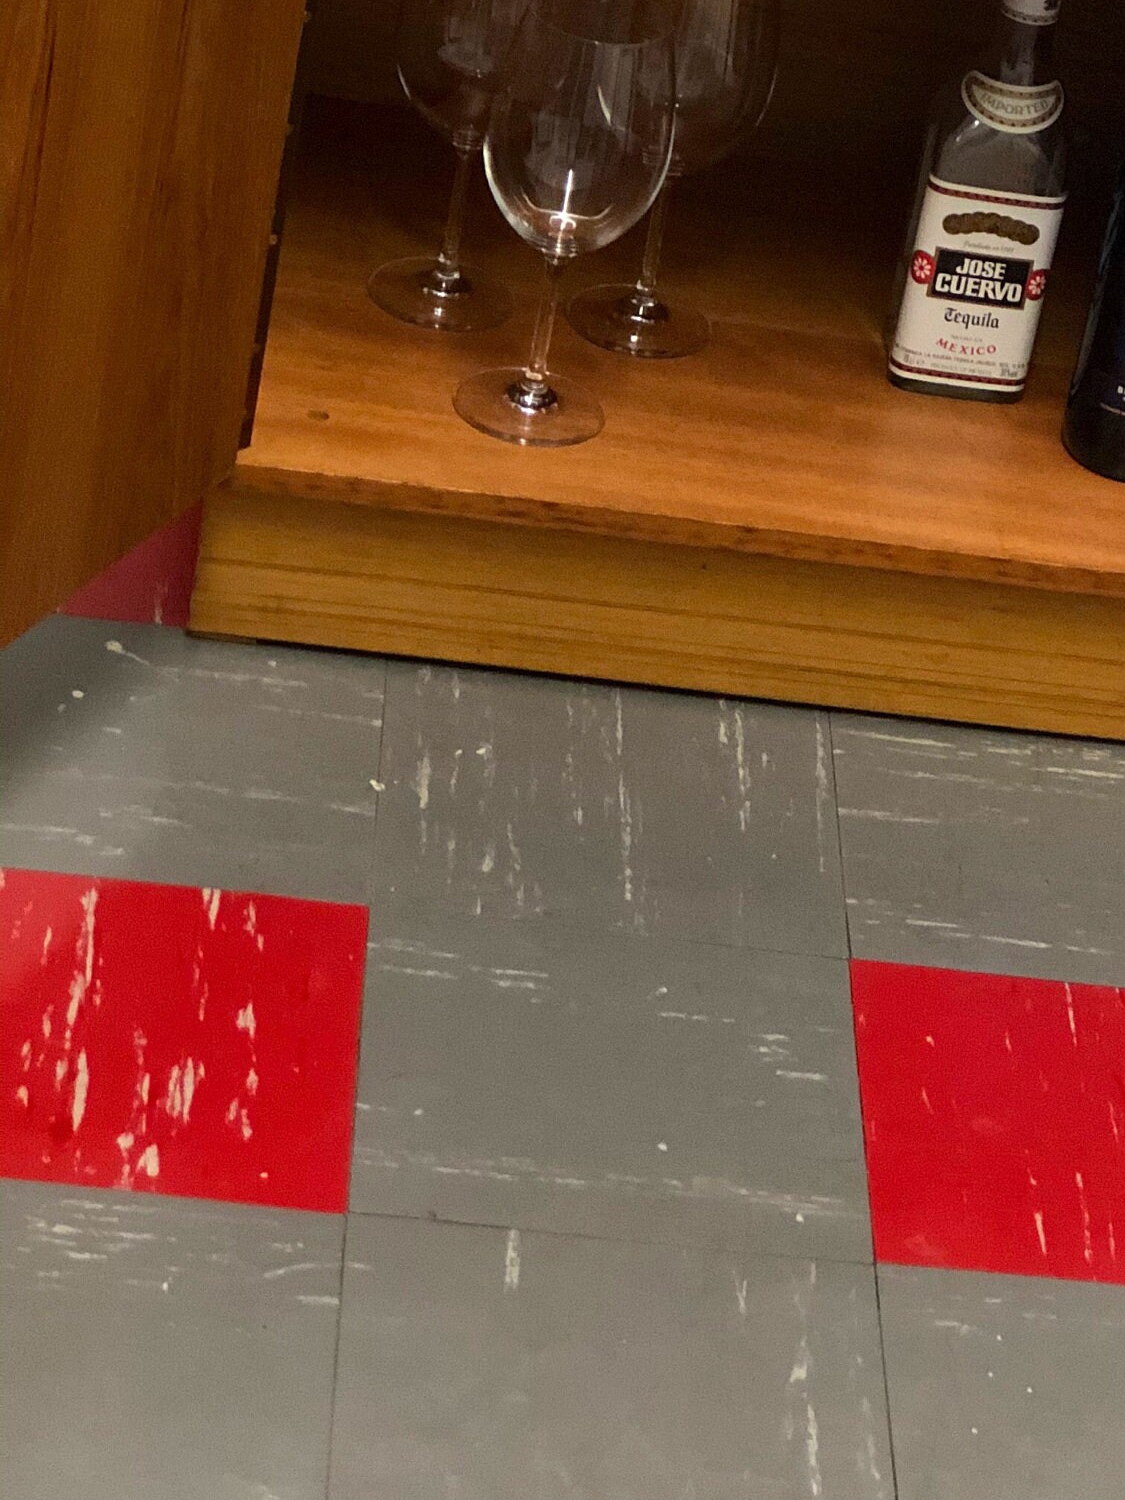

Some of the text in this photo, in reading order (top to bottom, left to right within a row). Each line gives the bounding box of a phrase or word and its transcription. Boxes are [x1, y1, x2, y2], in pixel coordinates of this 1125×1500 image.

[982, 91, 1049, 115] IMPORTED
[955, 258, 1007, 280] JOSE
[935, 272, 1023, 302] CUERVO
[944, 307, 1000, 329] Tequila
[936, 337, 997, 355] MEXICO
